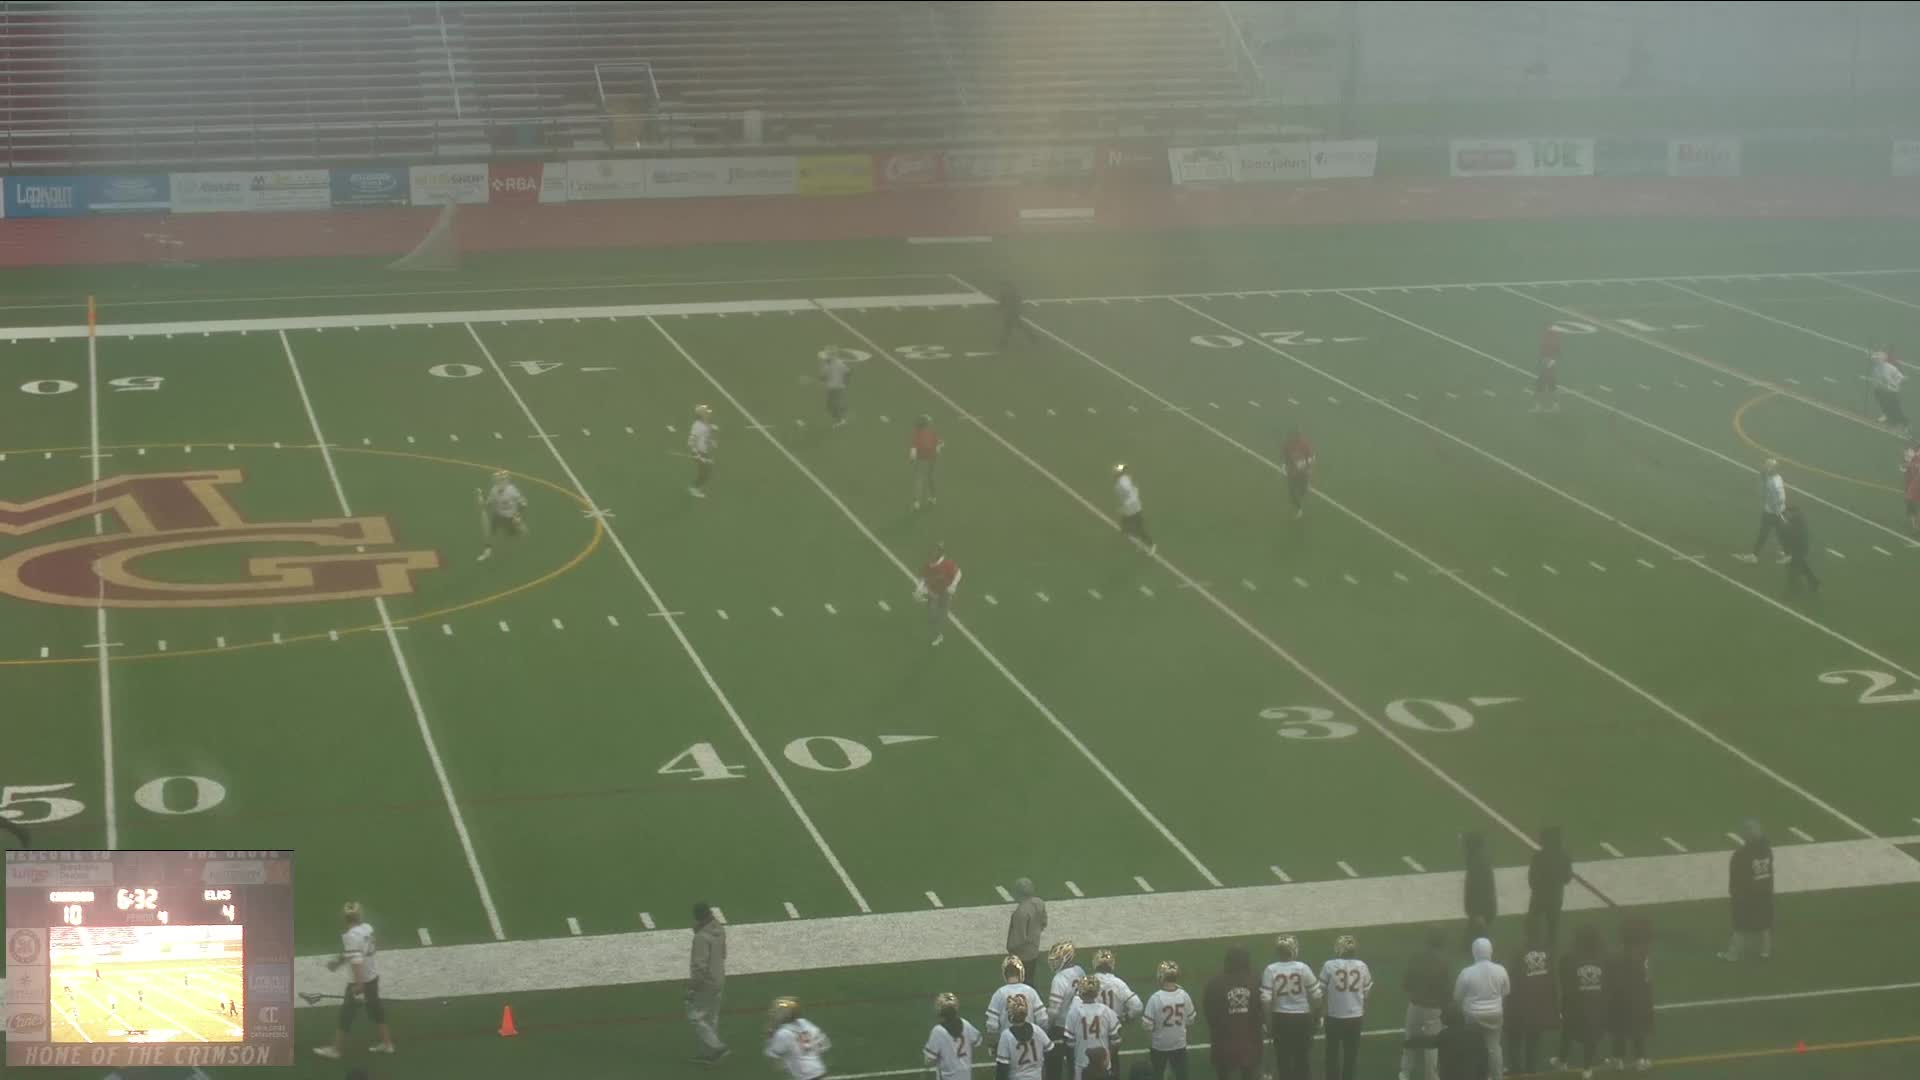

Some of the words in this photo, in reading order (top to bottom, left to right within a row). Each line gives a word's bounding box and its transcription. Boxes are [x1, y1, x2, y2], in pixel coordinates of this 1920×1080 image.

[506, 177, 537, 191] RBA
[117, 888, 158, 909] 6:32
[204, 890, 232, 901] ELKS
[64, 905, 82, 925] 10
[221, 905, 234, 923] 4
[1275, 974, 1302, 996] 23
[1335, 970, 1361, 992] 32
[1163, 1004, 1185, 1026] 25
[1081, 1016, 1100, 1040] 14
[26, 1047, 81, 1064] HOME
[92, 1046, 121, 1064] OF
[128, 1046, 168, 1064] THE
[176, 1046, 271, 1064] CRIMSON
[1016, 1039, 1038, 1065] 21
